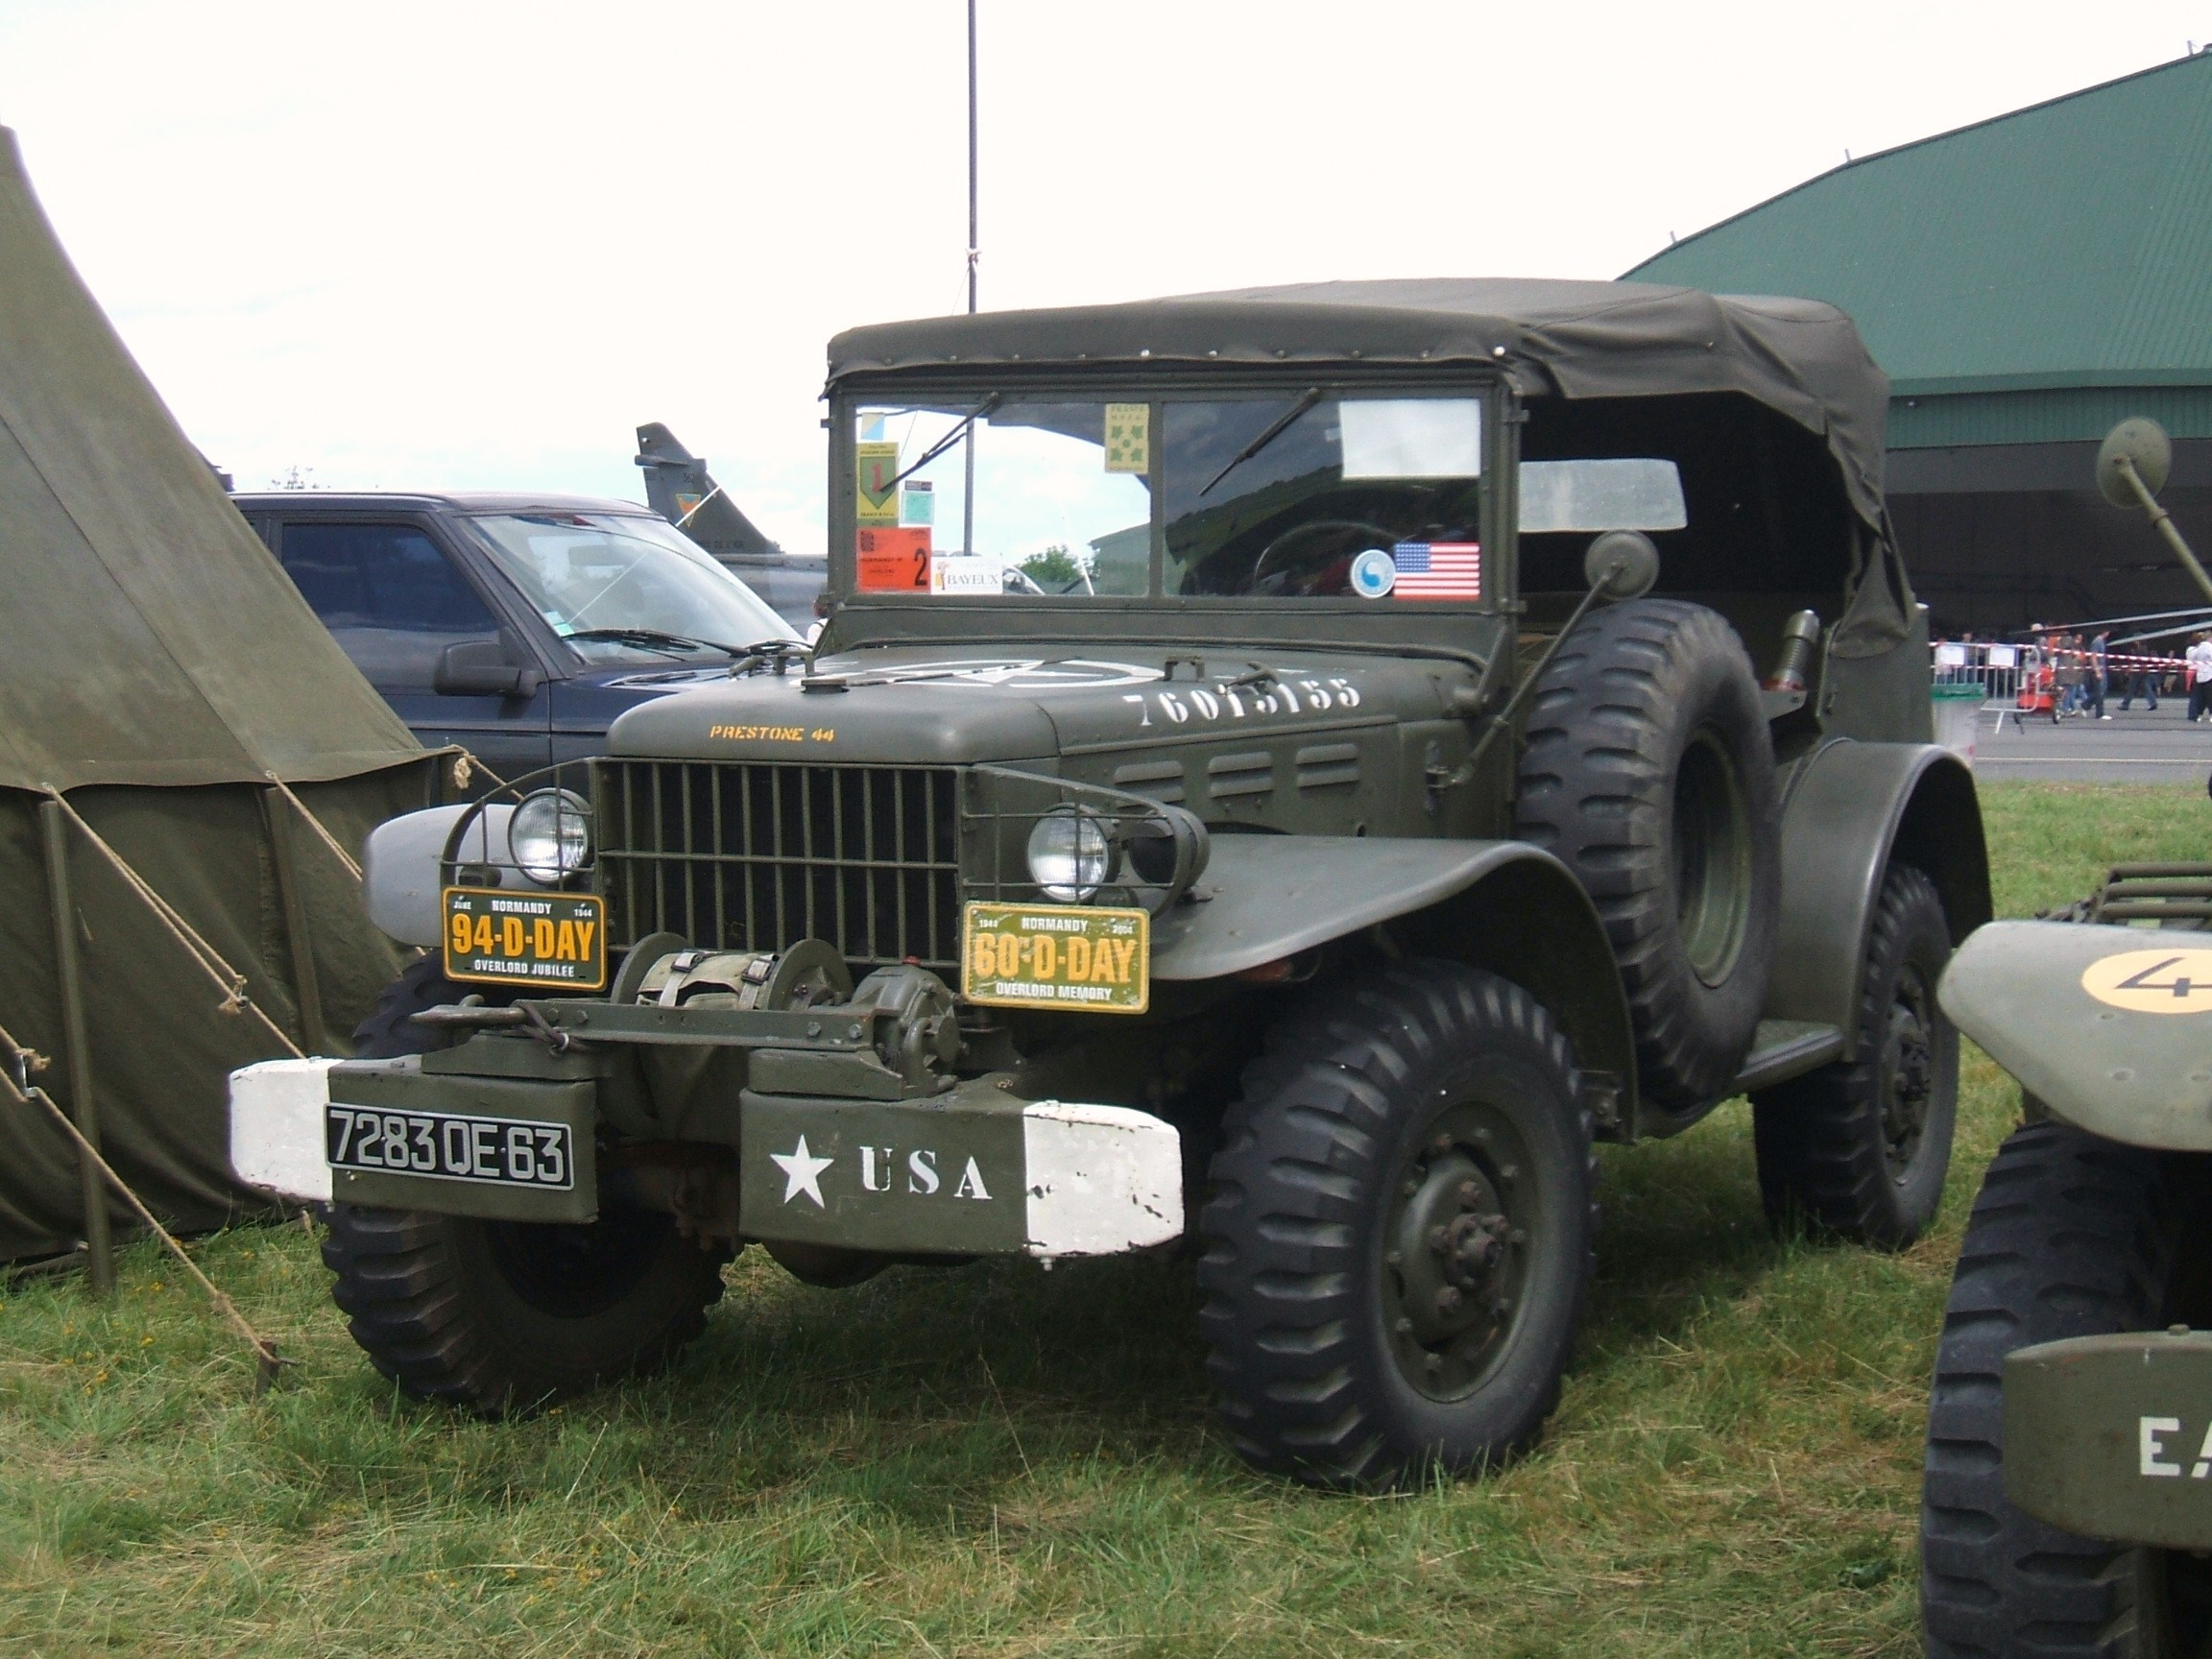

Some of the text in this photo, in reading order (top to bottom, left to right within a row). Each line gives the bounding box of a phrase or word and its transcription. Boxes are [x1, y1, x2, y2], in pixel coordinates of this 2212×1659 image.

[914, 548, 927, 587] 2
[948, 574, 998, 585] BAYEUX
[709, 725, 835, 742] PRESTONE 44
[454, 900, 592, 917] JUNE NORMANDY 1944
[978, 917, 1134, 934] 1944 NORMANDY 2004
[452, 913, 595, 962] 94-D-DAY
[474, 959, 575, 977] OVERLORD JUBILEE
[2114, 956, 2212, 998] 4
[996, 983, 1113, 1000] OVERLORD MEMORY
[329, 1110, 436, 1171] 7283
